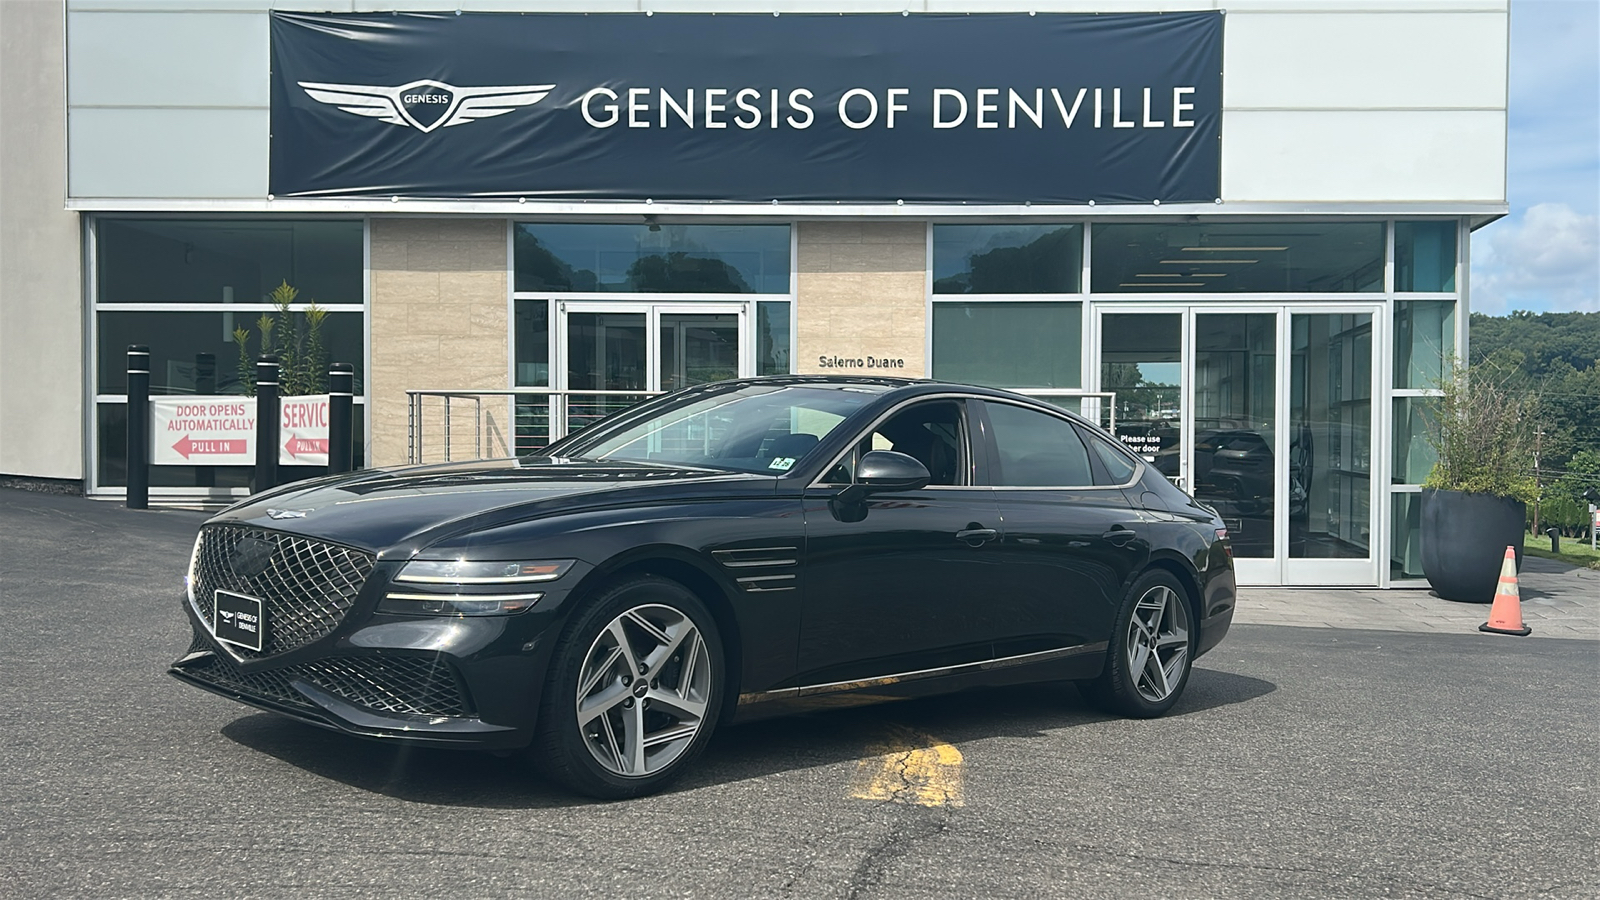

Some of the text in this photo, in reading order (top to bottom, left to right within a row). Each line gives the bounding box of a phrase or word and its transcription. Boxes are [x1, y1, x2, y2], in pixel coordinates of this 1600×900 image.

[403, 94, 449, 104] GENESIS
[580, 86, 1196, 130] GENESIS OF DENVILLE
[818, 355, 904, 368] Salerno Duane
[176, 403, 246, 418] DOOR OPENS
[283, 402, 330, 429] SERVIC
[167, 418, 256, 432] AUTOMATICALLY
[1120, 435, 1146, 443] Please
[191, 440, 231, 453] PULL IN
[296, 441, 313, 452] PULL
[1142, 444, 1161, 453] door
